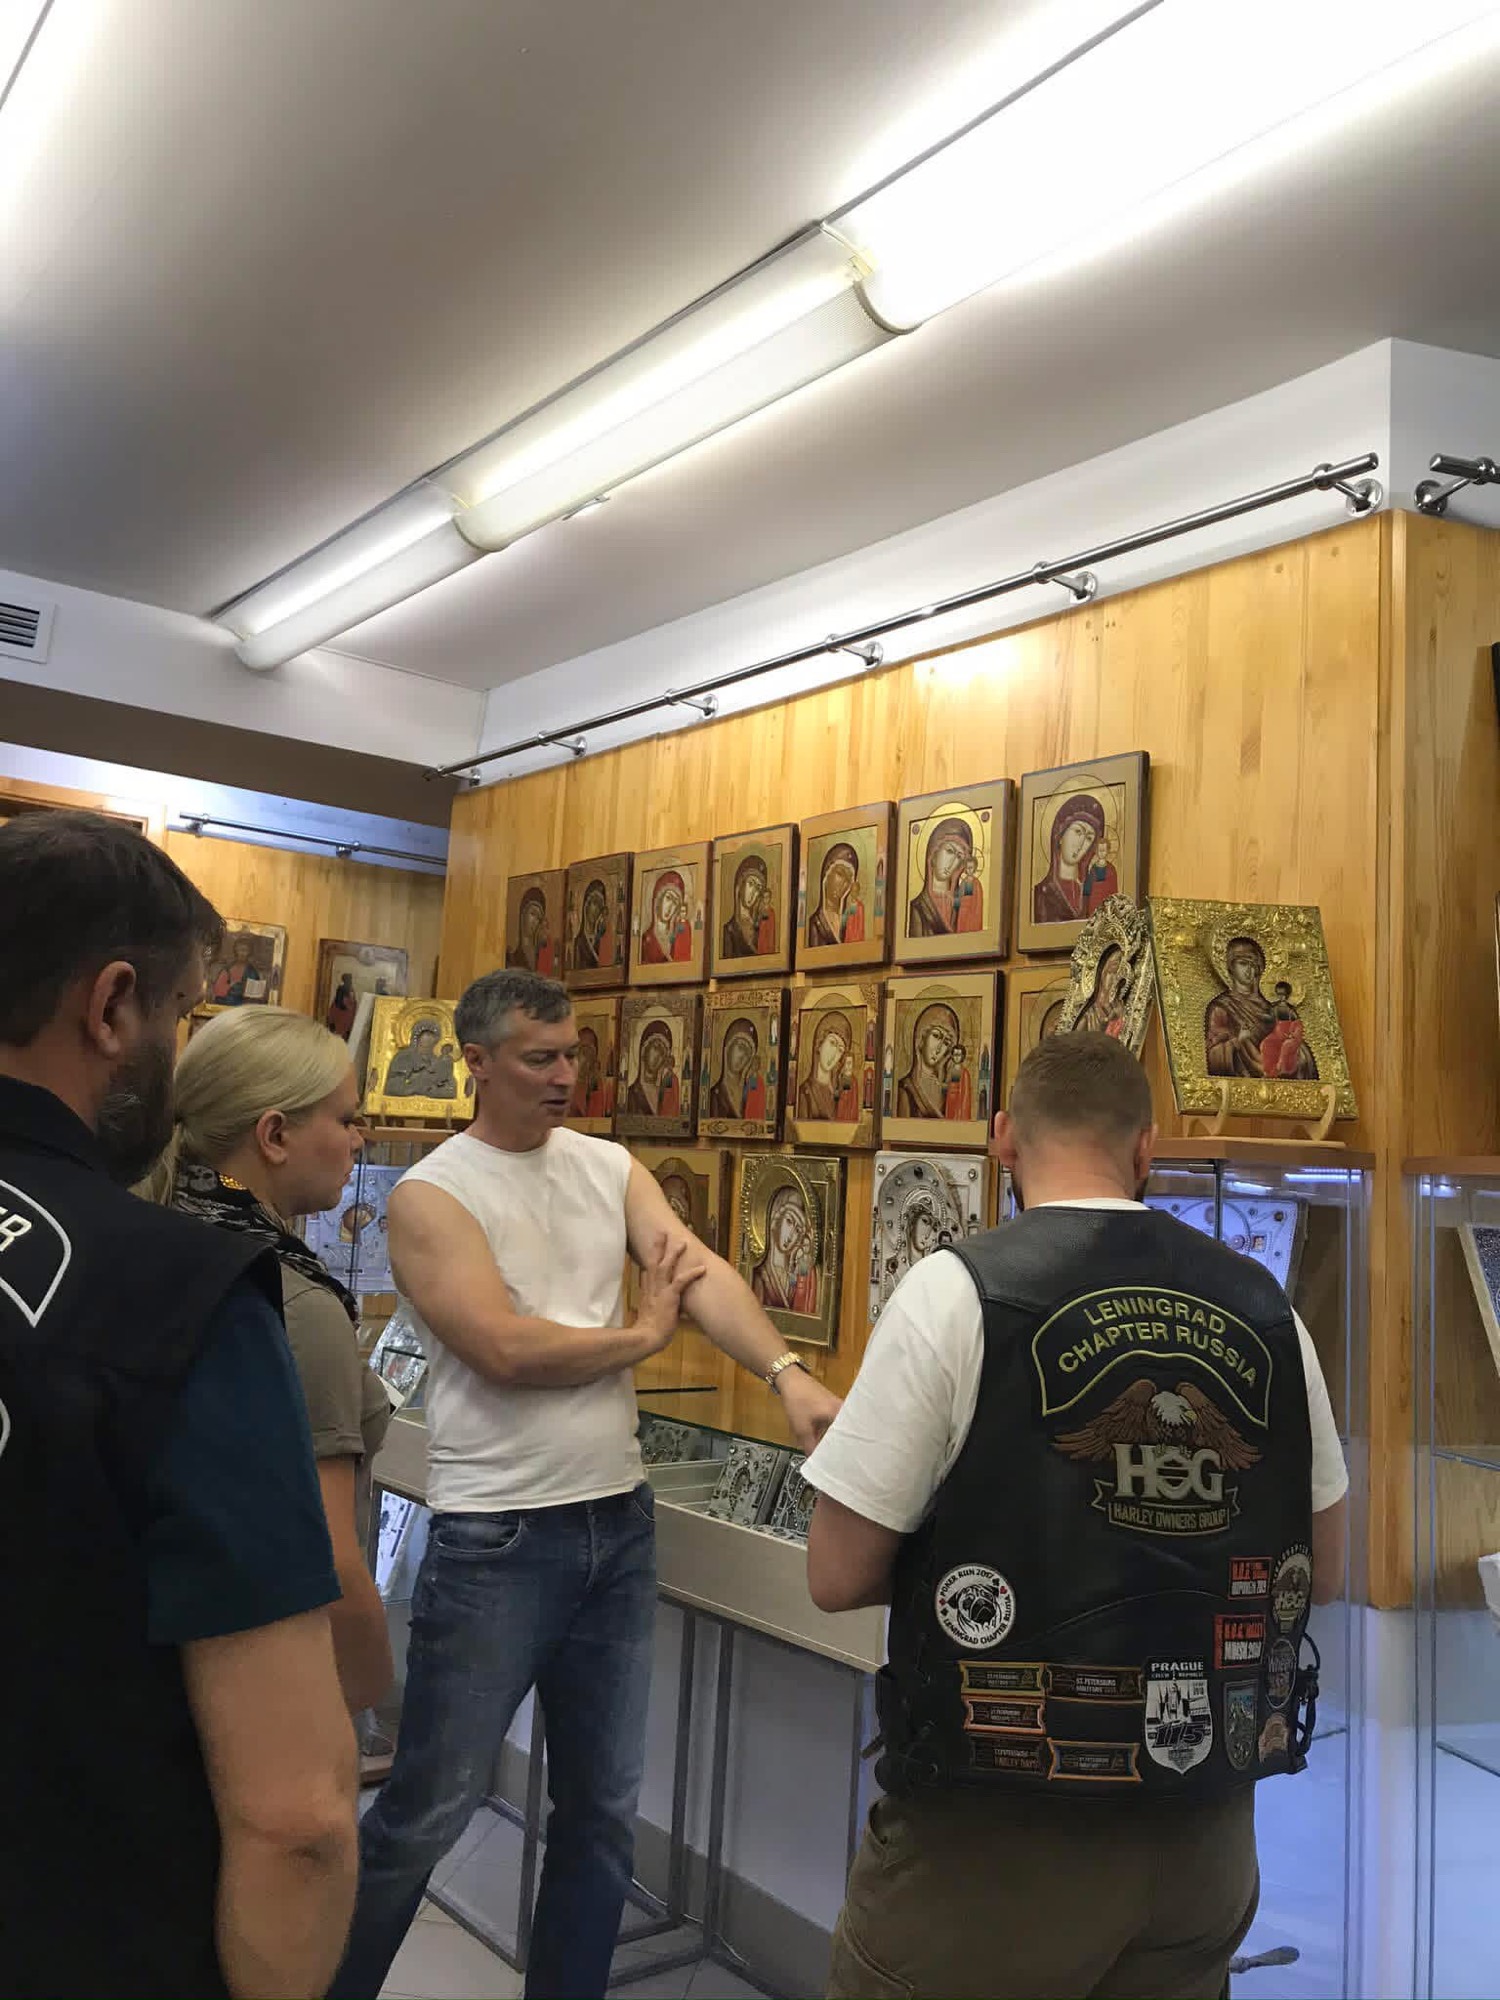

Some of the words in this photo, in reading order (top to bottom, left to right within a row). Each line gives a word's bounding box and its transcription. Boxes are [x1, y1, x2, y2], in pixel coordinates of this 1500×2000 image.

[1084, 1297, 1226, 1335] LENINGRAD
[1058, 1322, 1169, 1373] CHAPTER
[1176, 1325, 1257, 1387] RUSSIA
[1112, 1443, 1223, 1500] HOG
[1113, 1502, 1154, 1526] HARLEY
[1156, 1511, 1197, 1529] OWNERS
[1199, 1509, 1226, 1529] GROUP
[941, 1574, 958, 1597] POKER
[958, 1569, 975, 1579] RUN
[943, 1618, 979, 1645] LENINGRAD
[980, 1622, 1008, 1645] CHAPTER
[1151, 1661, 1204, 1672] PRAGUE
